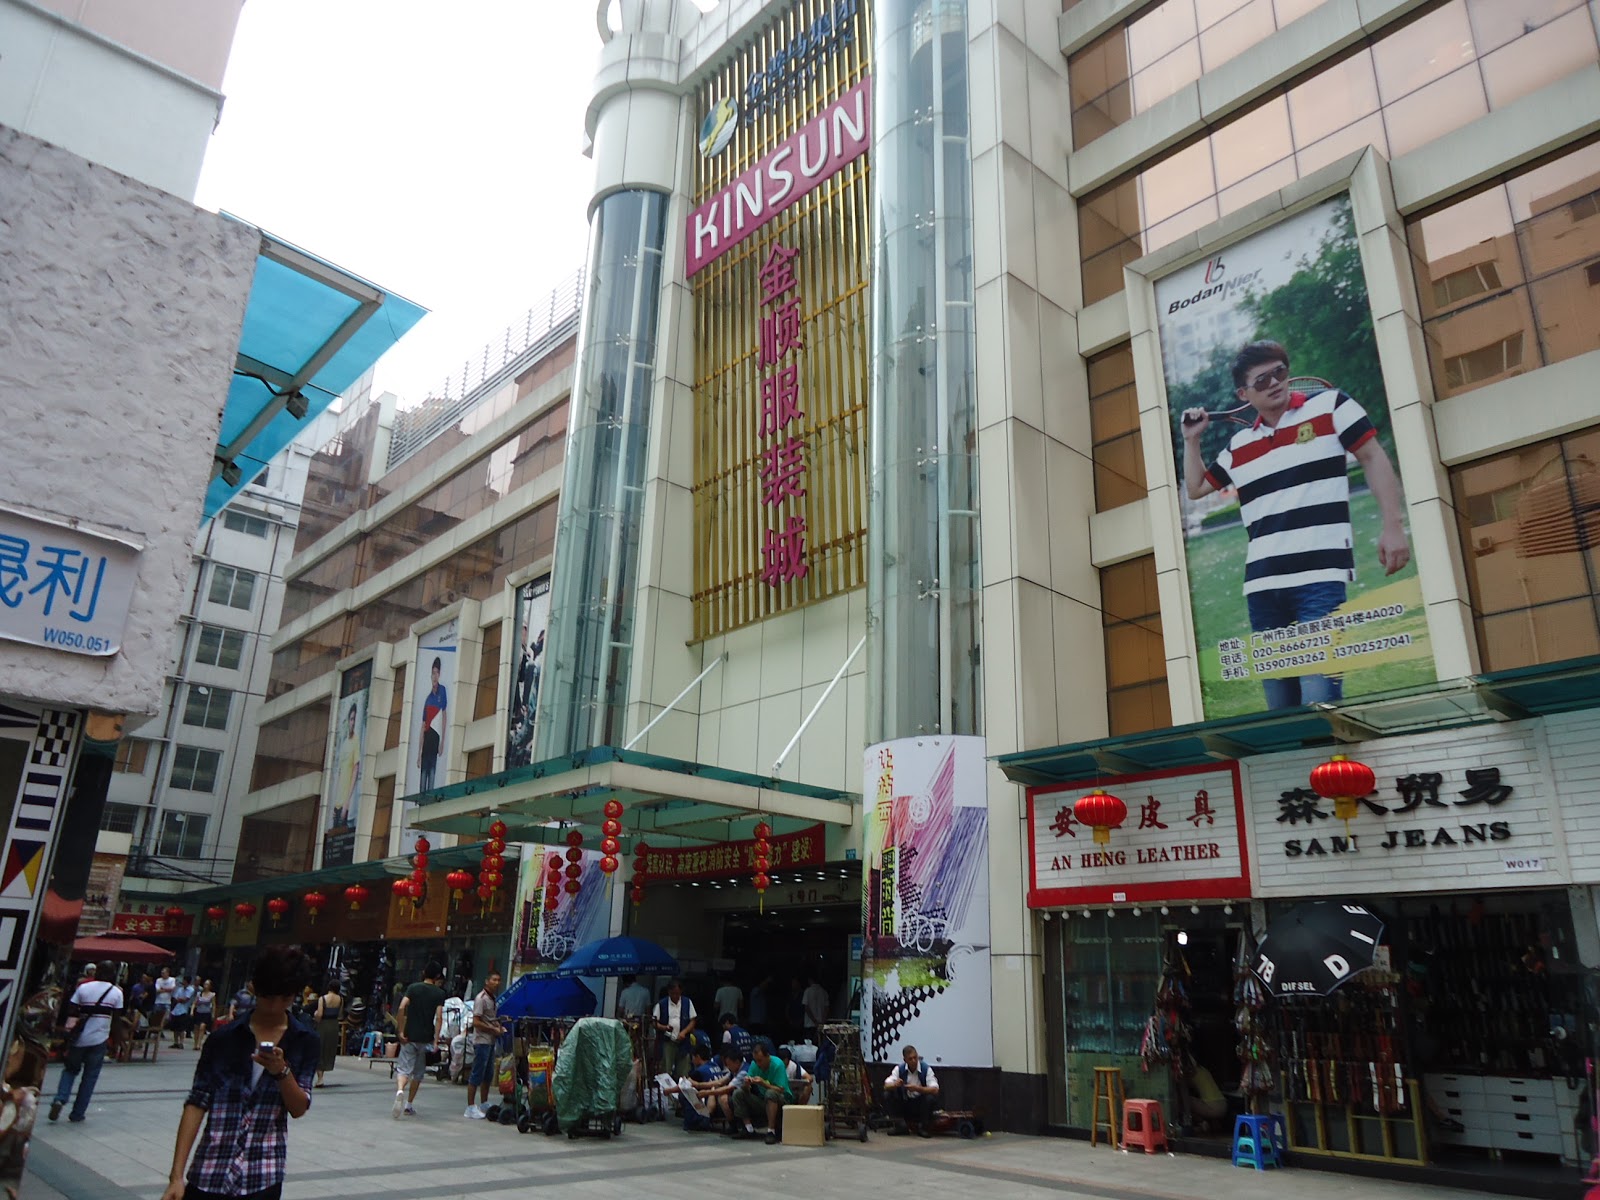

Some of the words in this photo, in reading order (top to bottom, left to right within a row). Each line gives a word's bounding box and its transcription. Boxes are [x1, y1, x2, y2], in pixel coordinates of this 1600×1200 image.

[694, 89, 866, 260] KINSUN
[758, 242, 808, 588] 金顺服装城
[44, 627, 110, 651] W050.051
[1253, 635, 1331, 659] 020-86667215
[1255, 651, 1325, 673] 13590783262
[1334, 634, 1411, 657] 13702527041
[1049, 789, 1216, 838] 安皮具
[1276, 767, 1513, 825] 森贸易
[1051, 855, 1072, 871] AN
[1081, 850, 1126, 868] HENG
[1137, 843, 1220, 864] LEATHER
[1284, 834, 1358, 857] SAM
[1381, 821, 1512, 850] JEANS
[1506, 858, 1539, 869] W017
[1257, 953, 1275, 983] 78
